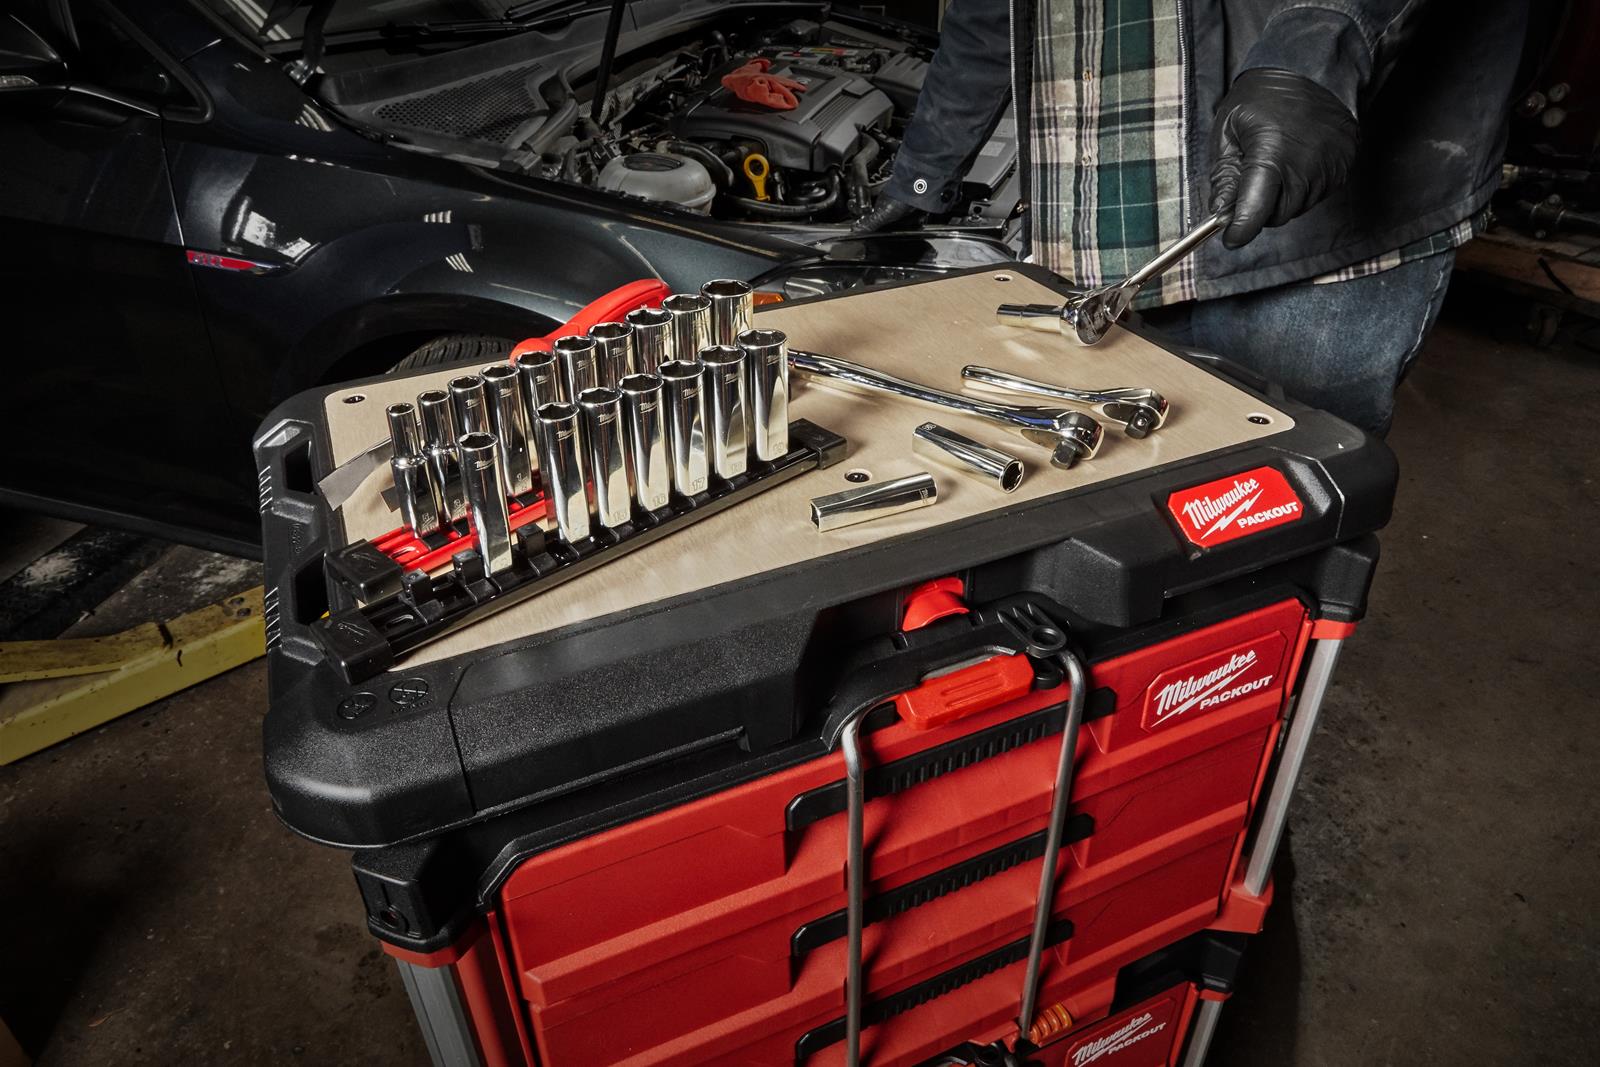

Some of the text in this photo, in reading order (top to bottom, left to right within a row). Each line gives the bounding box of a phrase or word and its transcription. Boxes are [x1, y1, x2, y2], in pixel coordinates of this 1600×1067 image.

[692, 477, 705, 491] 17
[1181, 478, 1260, 530] Milwaukee
[1237, 502, 1299, 529] PACKOUT
[1153, 649, 1257, 716] Milwaukee
[1200, 674, 1273, 710] PACKOUT
[1072, 1012, 1152, 1066] Milwaukee
[1108, 1022, 1167, 1055] PACKOUT
